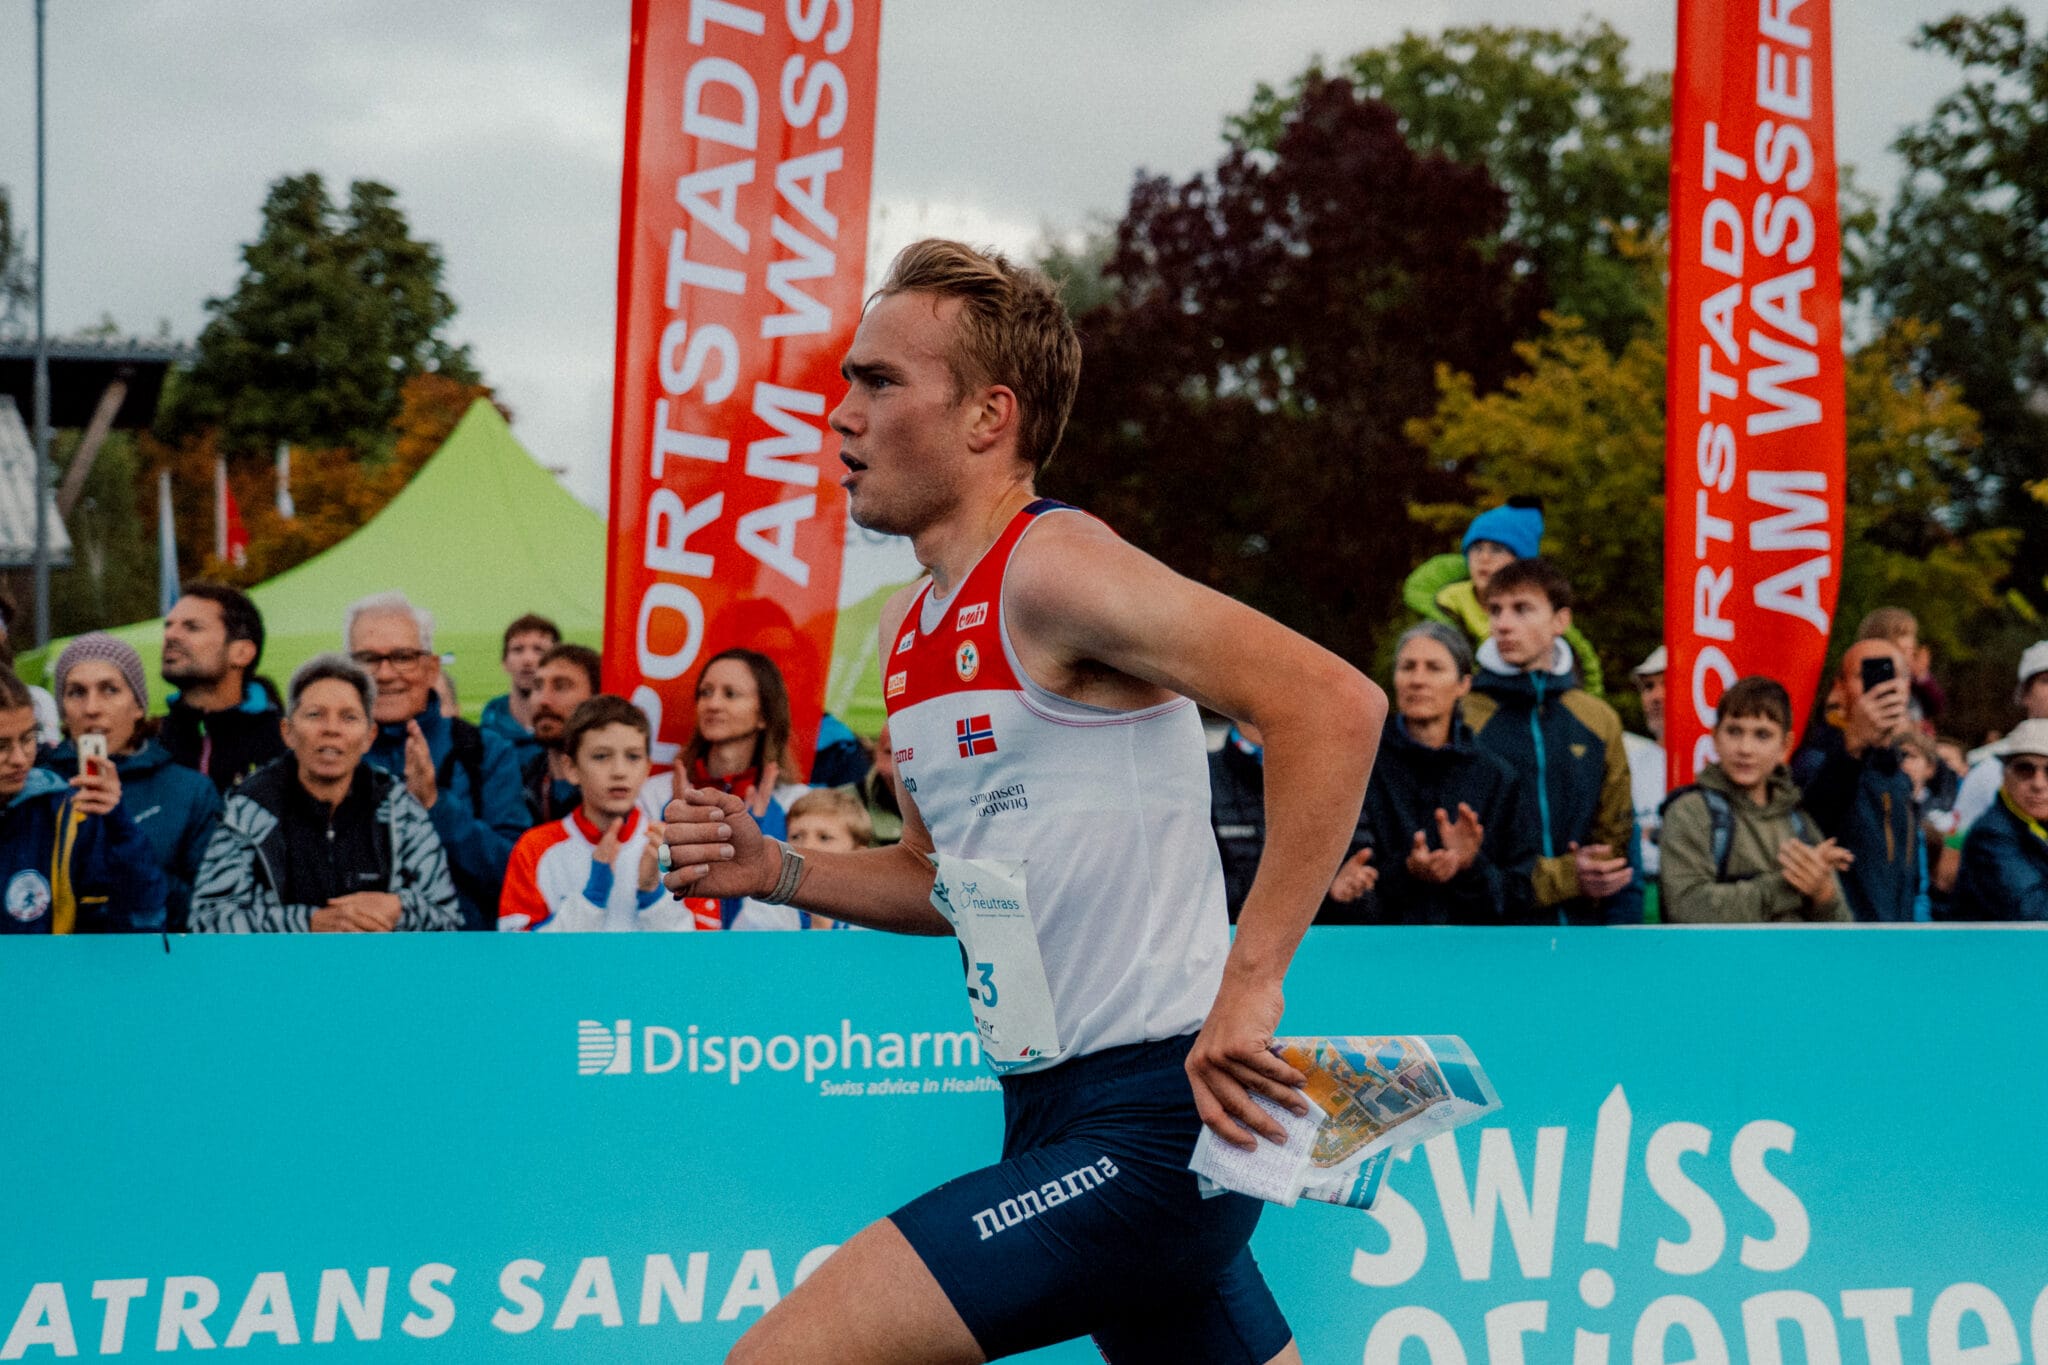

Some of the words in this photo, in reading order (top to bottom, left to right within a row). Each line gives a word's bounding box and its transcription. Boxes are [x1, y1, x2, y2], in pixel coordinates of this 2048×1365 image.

[734, 380, 826, 589] AM
[1746, 469, 1832, 636] AM
[972, 898, 1020, 910] neutrass
[643, 1018, 980, 1085] Dispopharm
[820, 1079, 864, 1097] Swiss
[867, 1078, 919, 1095] advice
[922, 1077, 939, 1093] in
[0, 1262, 457, 1361] ATRANS
[491, 1244, 841, 1334] SANA
